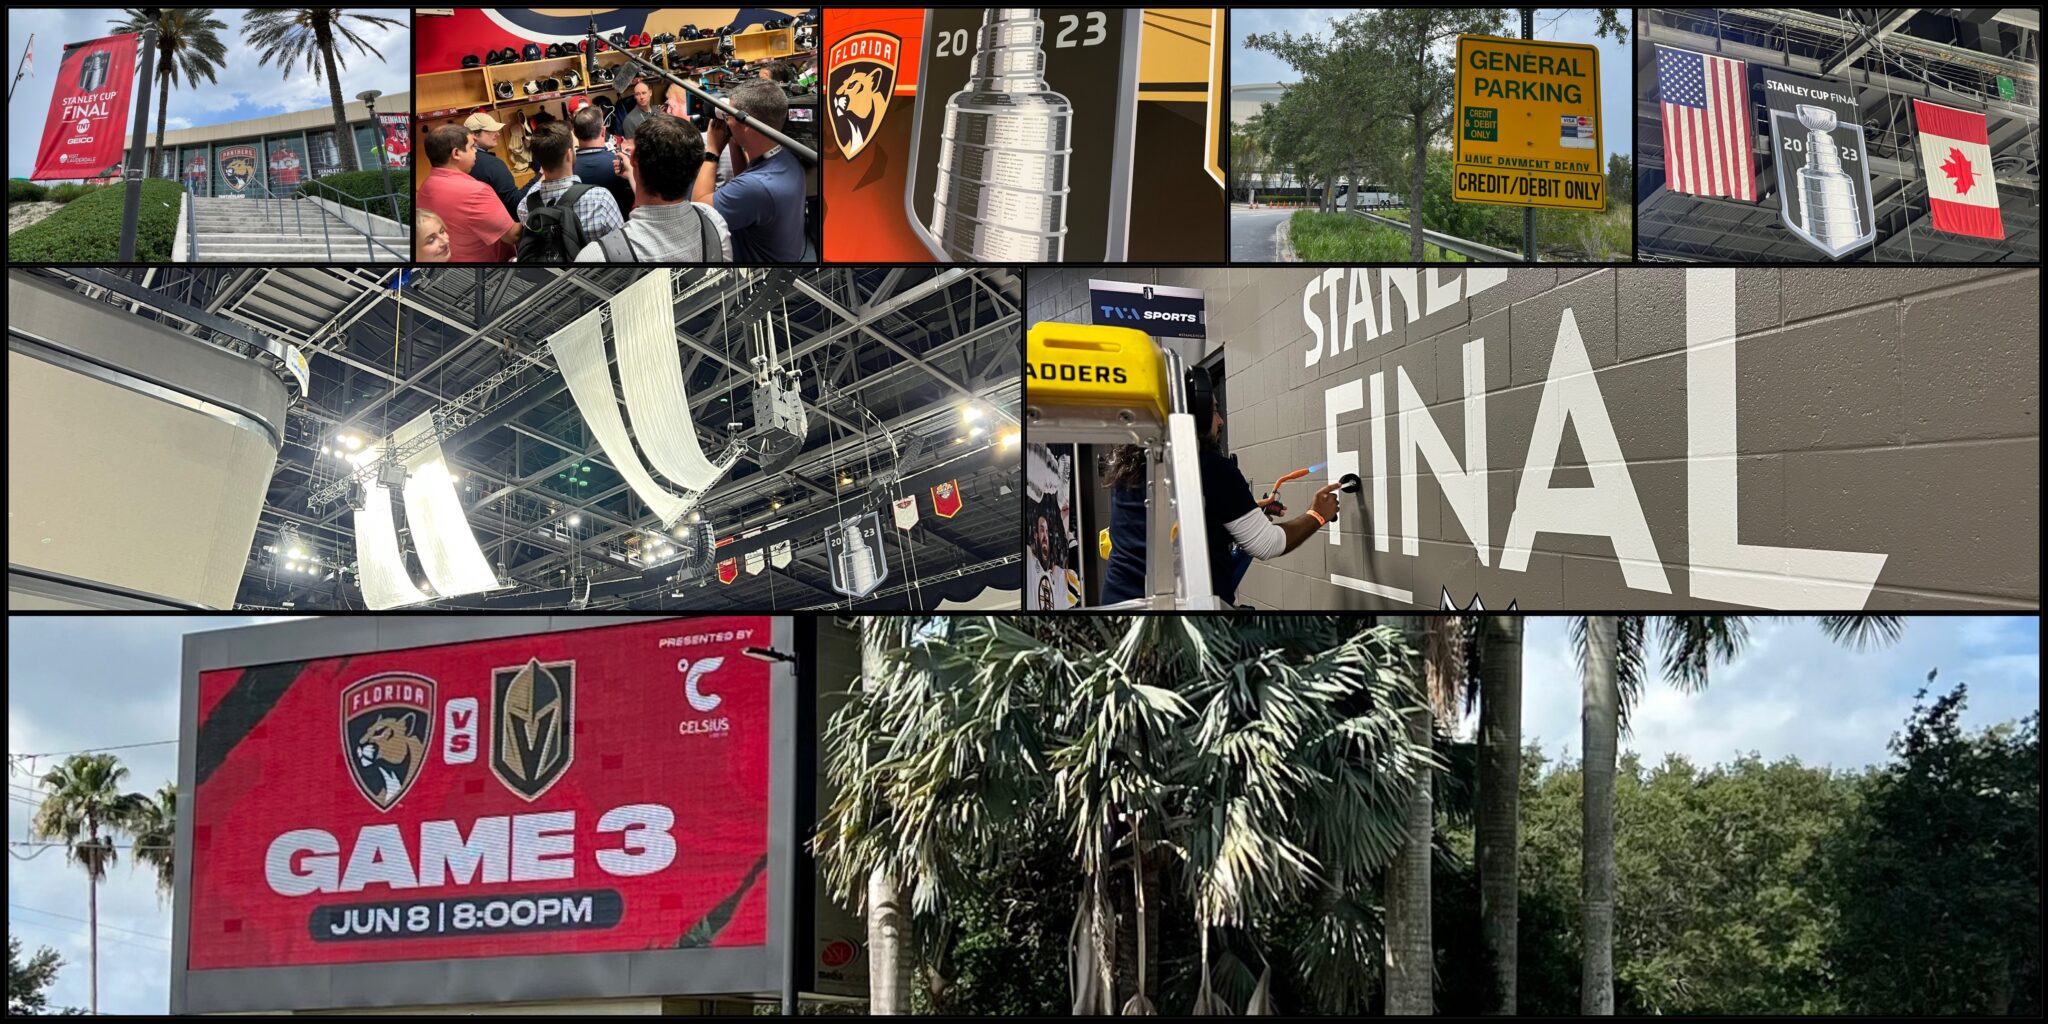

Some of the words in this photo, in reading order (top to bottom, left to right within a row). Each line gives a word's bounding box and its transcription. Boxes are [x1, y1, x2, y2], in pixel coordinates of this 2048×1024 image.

[1055, 11, 1108, 49] 23
[936, 28, 969, 58] 20
[834, 42, 892, 65] FLORIDA
[1469, 50, 1586, 78] GENERAL
[62, 93, 98, 106] STANLEY
[99, 91, 117, 101] CUP
[1474, 77, 1582, 104] PARKING
[1766, 80, 1809, 97] STANLEY
[1810, 89, 1830, 101] CUP
[1830, 93, 1860, 106] FINAL
[62, 102, 109, 119] FINAL
[1469, 108, 1493, 118] CREDIT
[77, 123, 90, 131] TNT
[1464, 120, 1471, 128] &
[1473, 119, 1497, 129] DEBIT
[67, 136, 93, 144] GEICO
[1470, 129, 1492, 139] ONLY
[1783, 136, 1803, 152] 20
[1841, 146, 1859, 161] 23
[1458, 172, 1561, 198] CREDIT/DEBIT
[1564, 180, 1601, 201] ONLY
[1143, 310, 1197, 323] SPORTS
[1324, 267, 1888, 610] FINAL
[831, 537, 842, 546] 20
[864, 528, 875, 538] 23
[658, 631, 734, 649] PRESENTED
[736, 629, 754, 640] BY
[352, 684, 425, 712] FLORIDA
[679, 718, 730, 735] CELSIUS
[264, 810, 576, 897] GAME
[595, 803, 678, 878] 3
[330, 907, 401, 936] JUN
[406, 903, 432, 933] 8
[452, 896, 593, 929] 8:00PM
